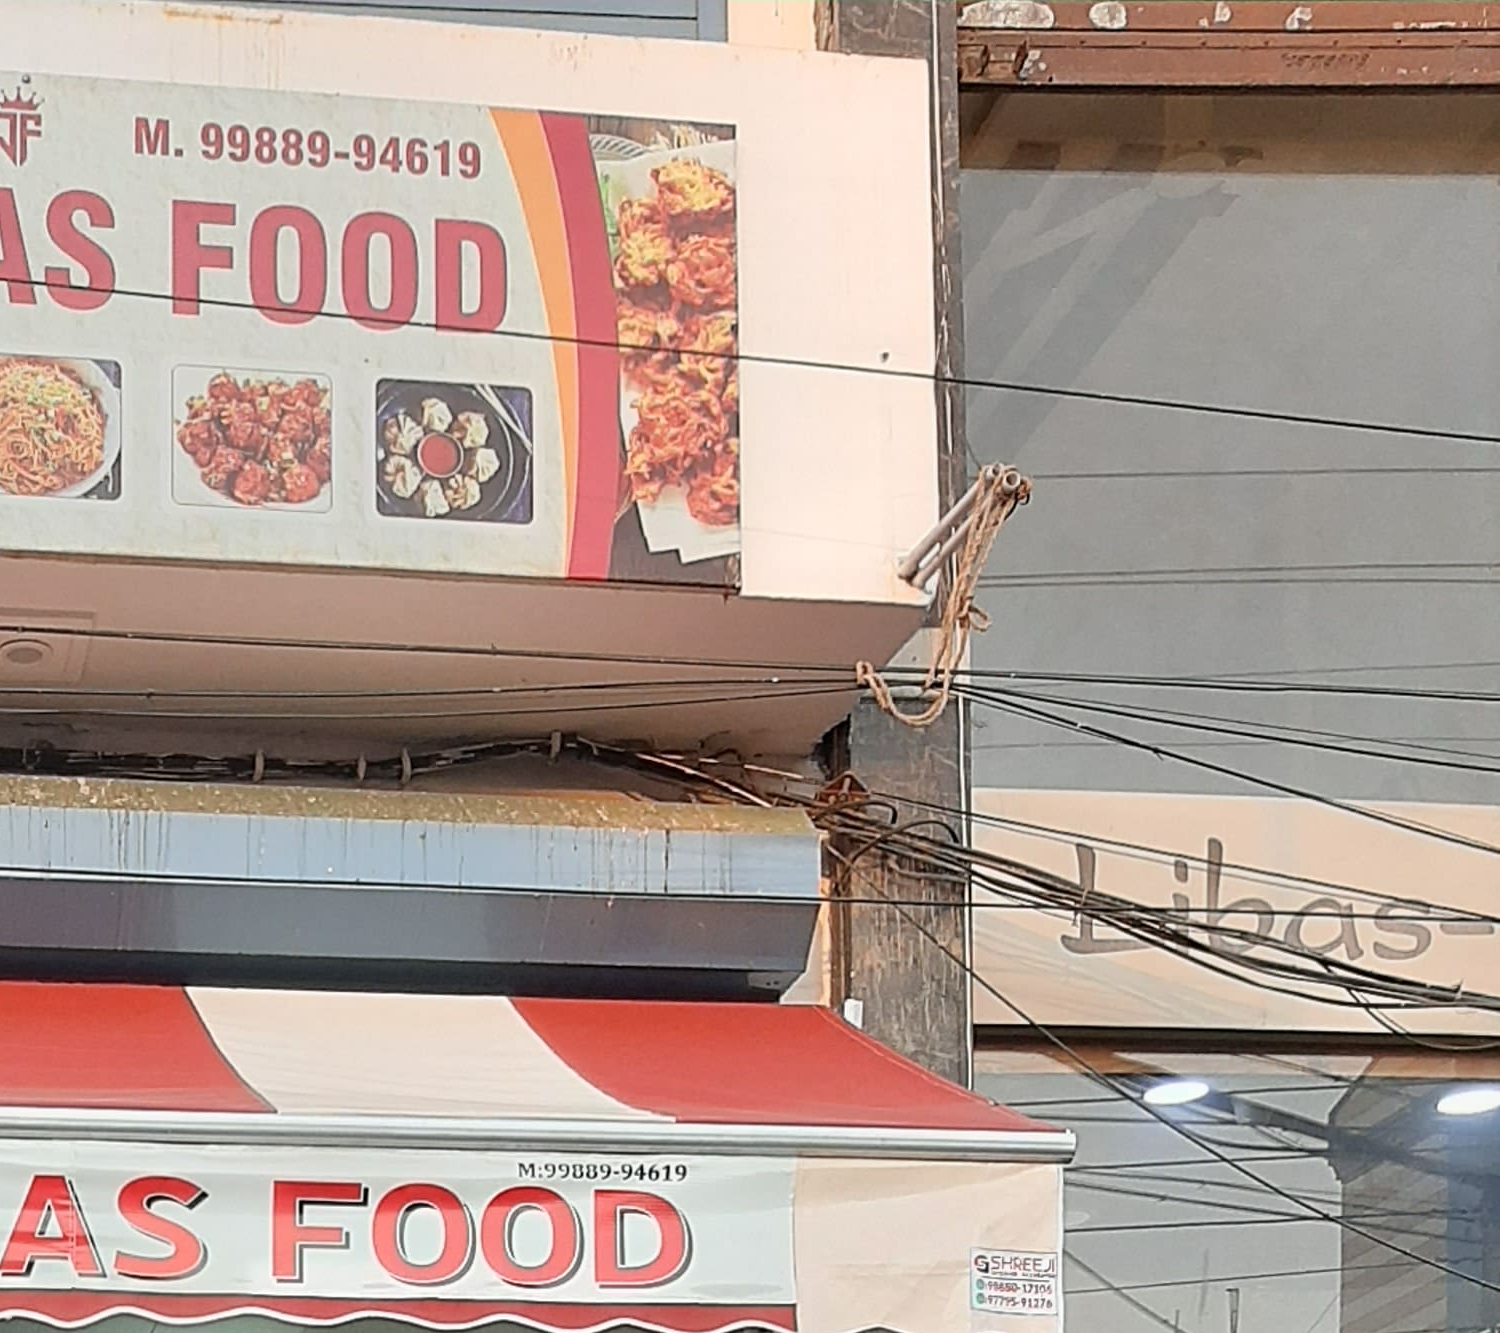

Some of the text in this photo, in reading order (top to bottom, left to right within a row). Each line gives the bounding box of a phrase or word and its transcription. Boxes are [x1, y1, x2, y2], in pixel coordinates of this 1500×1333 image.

[133, 116, 483, 180] M. 99889-94619
[171, 199, 508, 334] FOOD
[271, 1179, 693, 1289] FOOD
